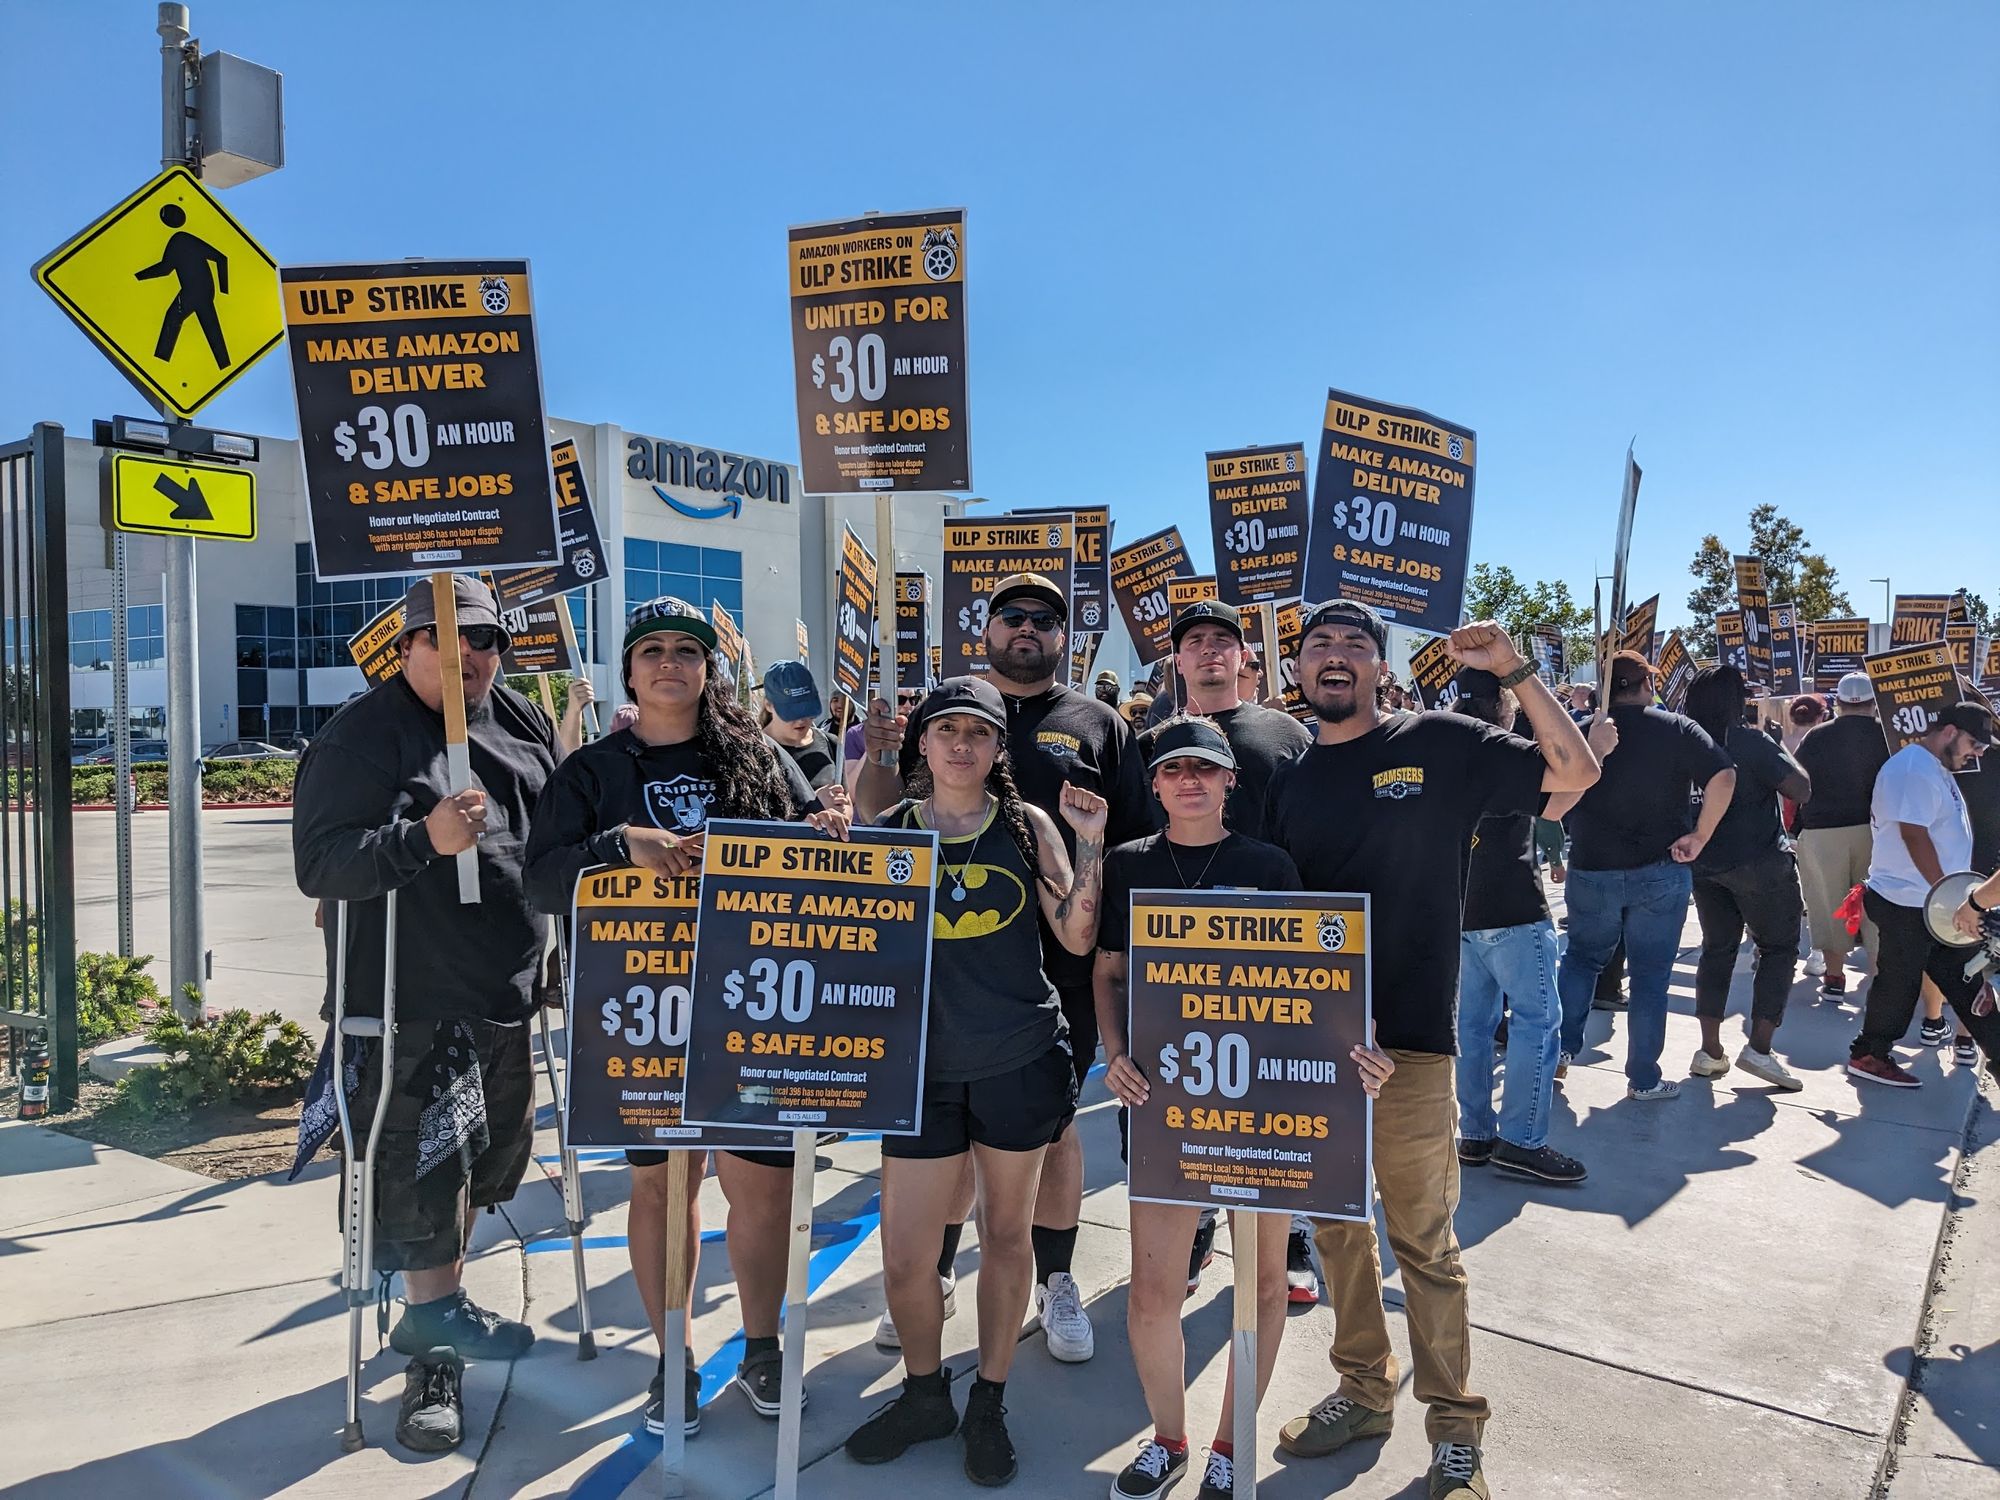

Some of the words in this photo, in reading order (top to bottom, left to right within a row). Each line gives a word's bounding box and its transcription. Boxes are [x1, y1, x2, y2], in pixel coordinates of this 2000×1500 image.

[800, 245, 840, 260] AMAZON
[842, 237, 892, 254] WORKERS
[896, 236, 913, 249] ON
[800, 263, 835, 288] ULP
[841, 255, 912, 283] STRIKE
[300, 288, 354, 316] ULP
[368, 283, 467, 313] STRIKE
[805, 301, 885, 330] UNITED
[895, 297, 948, 323] FOR
[306, 337, 389, 363] MAKE
[396, 331, 520, 358] AMAZON
[350, 363, 487, 395] DELIVER
[812, 333, 886, 403] $30
[894, 358, 911, 376] AN
[913, 356, 948, 375] HOUR
[815, 414, 830, 435] &
[834, 410, 884, 434] SAFE
[889, 407, 950, 432] JOBS
[1336, 408, 1370, 431] ULP
[1377, 418, 1440, 449] STRIKE
[334, 403, 431, 470] $30
[437, 424, 461, 446] AN
[466, 421, 515, 445] HOUR
[861, 443, 895, 456] Negotiated
[896, 442, 926, 453] Contract
[627, 436, 790, 504] amazon
[1213, 463, 1235, 477] ULP
[1240, 457, 1280, 474] STRIKE
[1331, 442, 1384, 466] MAKE
[1388, 456, 1465, 488] AMAZON
[349, 482, 369, 504] &
[376, 478, 441, 503] SAFE
[445, 473, 514, 498] JOBS
[1215, 485, 1249, 501] MAKE
[1251, 479, 1300, 496] AMAZON
[1352, 470, 1441, 504] DELIVER
[369, 514, 395, 527] Honor
[397, 516, 412, 525] our
[413, 511, 461, 526] Negotiated
[462, 508, 500, 521] Contract
[1232, 497, 1288, 516] DELIVER
[368, 532, 403, 544] Teamsters
[404, 530, 422, 541] Local
[423, 530, 435, 539] 396
[436, 529, 448, 539] has
[449, 529, 458, 538] no
[459, 527, 477, 537] labor
[478, 526, 503, 537] dispute
[1332, 496, 1397, 547] $30
[1400, 521, 1418, 540] AN
[1419, 525, 1450, 547] HOUR
[375, 543, 390, 553] with
[391, 543, 404, 553] any
[405, 540, 436, 551] employer
[437, 538, 455, 548] other
[456, 537, 471, 547] than
[472, 536, 499, 546] Amazon
[952, 531, 981, 547] ULP
[987, 529, 1040, 546] STRIKE
[1224, 518, 1265, 554] $30
[1267, 527, 1278, 540] AN
[1279, 524, 1299, 539] HOUR
[952, 559, 994, 573] MAKE
[997, 557, 1064, 573] AMAZON
[1131, 543, 1163, 564] STRIKE
[1230, 559, 1239, 572] &
[1240, 554, 1270, 569] SAFE
[1270, 551, 1298, 566] JOBS
[1333, 544, 1347, 562] &
[1350, 548, 1394, 572] SAFE
[1396, 559, 1442, 582] JOBS
[1115, 570, 1145, 589] MAKE
[1145, 553, 1184, 576] AMAZON
[1132, 569, 1178, 596] DELIVER
[1341, 570, 1359, 582] Honor
[1360, 576, 1370, 584] our
[1370, 577, 1403, 591] Negotiated
[1404, 583, 1429, 597] Contract
[1132, 591, 1169, 622] $30
[1175, 587, 1198, 599] ULP
[356, 641, 369, 658] ULP
[370, 617, 398, 646] STRIKE
[512, 636, 533, 647] SAFE
[535, 633, 558, 645] JOBS
[1722, 623, 1739, 632] ULP
[1893, 617, 1942, 642] STRIKE
[1818, 634, 1865, 653] STRIKE
[365, 653, 387, 677] MAKE
[1415, 654, 1429, 672] ULP
[1420, 663, 1444, 688] MAKE
[1654, 643, 1684, 691] STRIKE
[1872, 661, 1892, 674] ULP
[1897, 653, 1932, 669] STRIKE
[1878, 679, 1907, 692] MAKE
[1908, 671, 1952, 687] AMAZON
[1894, 686, 1943, 704] DELIVER
[1892, 705, 1927, 734] $30
[1037, 731, 1081, 752] TEAMSTERS
[653, 783, 717, 795] RAIDERS
[1372, 766, 1424, 790] TEAMSTERS
[720, 843, 770, 870] ULP
[782, 846, 873, 875] STRIKE
[592, 876, 642, 899] ULP
[715, 890, 793, 914] MAKE
[799, 894, 915, 921] AMAZON
[591, 921, 665, 942] MAKE
[750, 922, 878, 952] DELIVER
[1147, 914, 1196, 939] ULP
[1208, 916, 1303, 943] STRIKE
[723, 957, 815, 1023] $30
[820, 983, 845, 1006] AN
[849, 984, 896, 1008] HOUR
[1146, 962, 1221, 985] MAKE
[1228, 966, 1350, 991] AMAZON
[602, 985, 690, 1046] $30
[1181, 993, 1313, 1024] DELIVER
[725, 1031, 745, 1053] &
[751, 1033, 815, 1057] SAFE
[819, 1036, 886, 1060] JOBS
[740, 1066, 765, 1079] Honor
[767, 1070, 782, 1080] our
[783, 1068, 829, 1083] Negotiated
[831, 1070, 867, 1083] Contract
[1159, 1031, 1250, 1099] $30
[1257, 1057, 1282, 1081] AN
[1287, 1058, 1336, 1084] HOUR
[1166, 1106, 1185, 1129] &
[1191, 1110, 1254, 1134] SAFE
[1259, 1113, 1329, 1139] JOBS
[1182, 1142, 1207, 1155] Honor
[1208, 1146, 1223, 1156] our
[1224, 1146, 1272, 1160] Negotiated
[1273, 1149, 1312, 1163] Contract
[1179, 1160, 1213, 1172] Teamsters
[1214, 1163, 1231, 1174] Local
[1232, 1165, 1244, 1174] 396
[1245, 1165, 1258, 1176] has
[1259, 1169, 1268, 1177] no
[1269, 1167, 1287, 1178] labor
[1287, 1169, 1313, 1180] dispute
[1184, 1170, 1200, 1181] with
[1200, 1173, 1212, 1183] any
[1213, 1174, 1244, 1186] employer
[1245, 1176, 1263, 1186] other
[1264, 1177, 1280, 1188] than
[1281, 1178, 1308, 1189] Amazon
[1233, 1189, 1252, 1197] ALLIES
